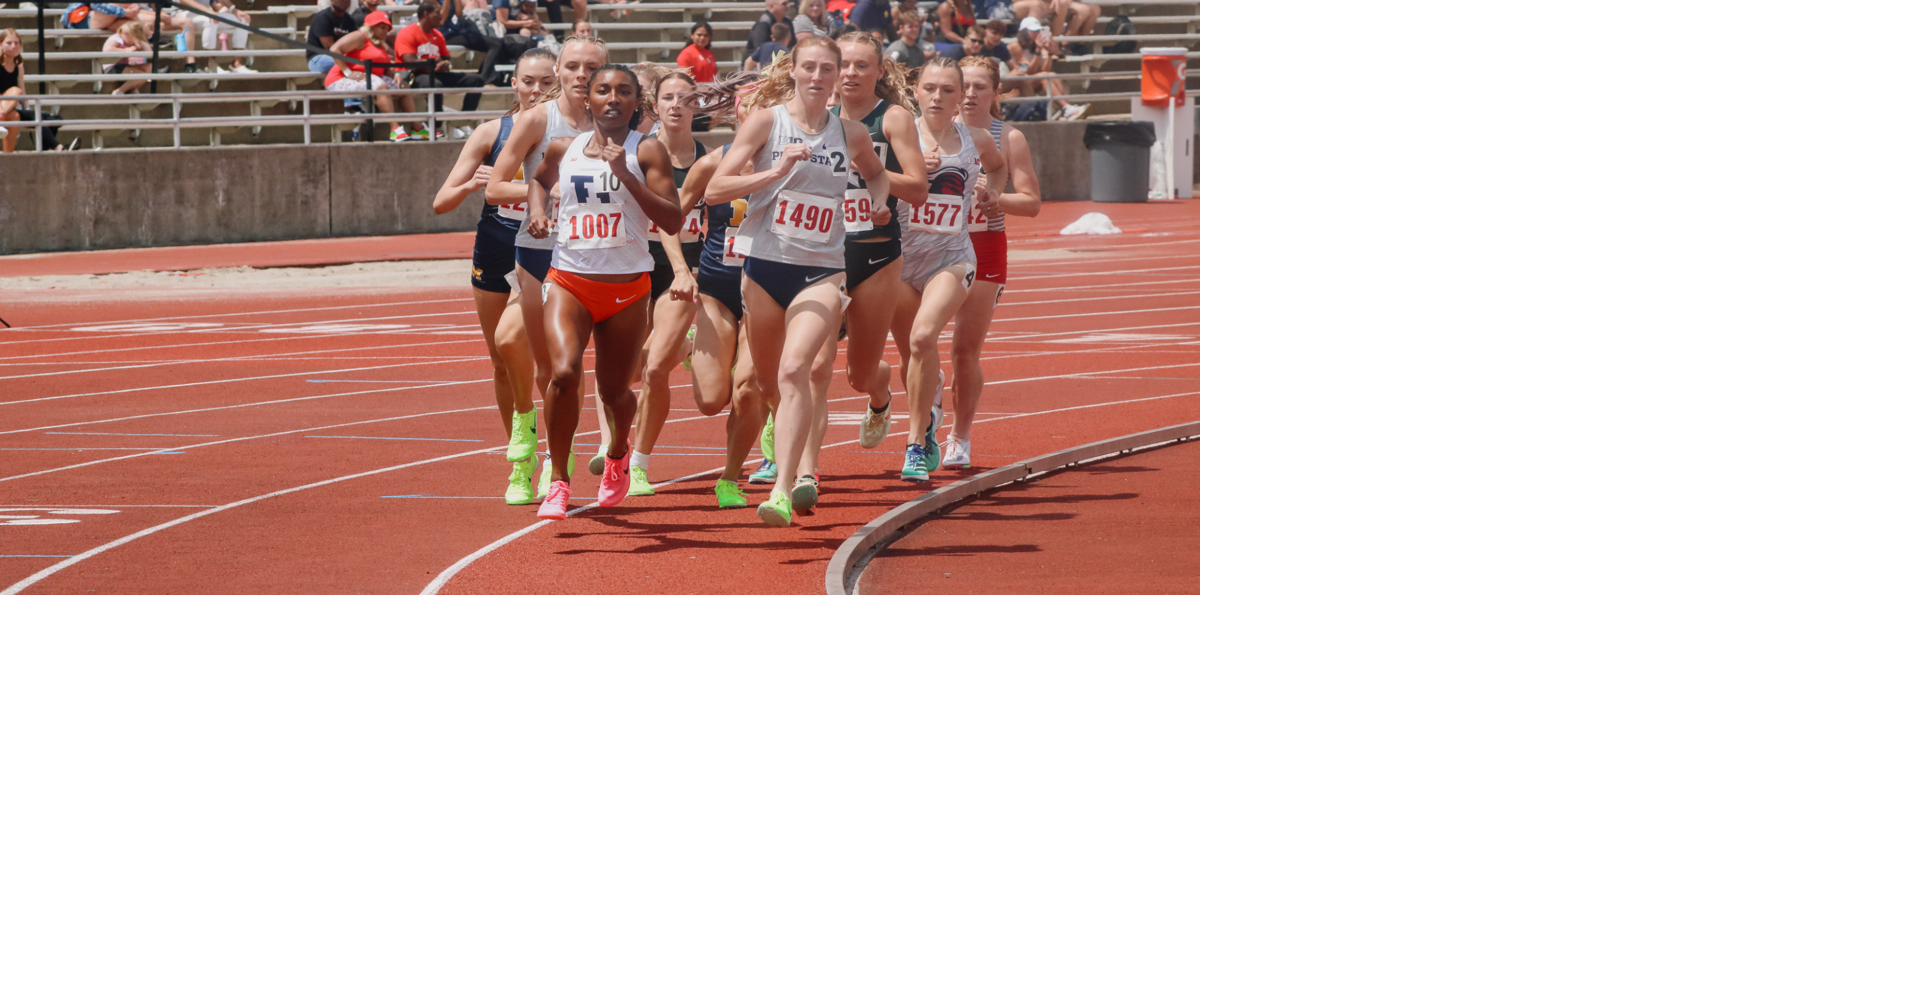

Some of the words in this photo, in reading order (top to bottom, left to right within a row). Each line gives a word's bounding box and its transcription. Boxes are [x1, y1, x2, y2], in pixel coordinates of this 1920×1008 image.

[830, 151, 847, 173] 2
[599, 171, 621, 192] 10
[775, 199, 834, 234] 1490
[844, 197, 872, 223] 59
[910, 202, 962, 227] 1577
[569, 212, 622, 240] 1007
